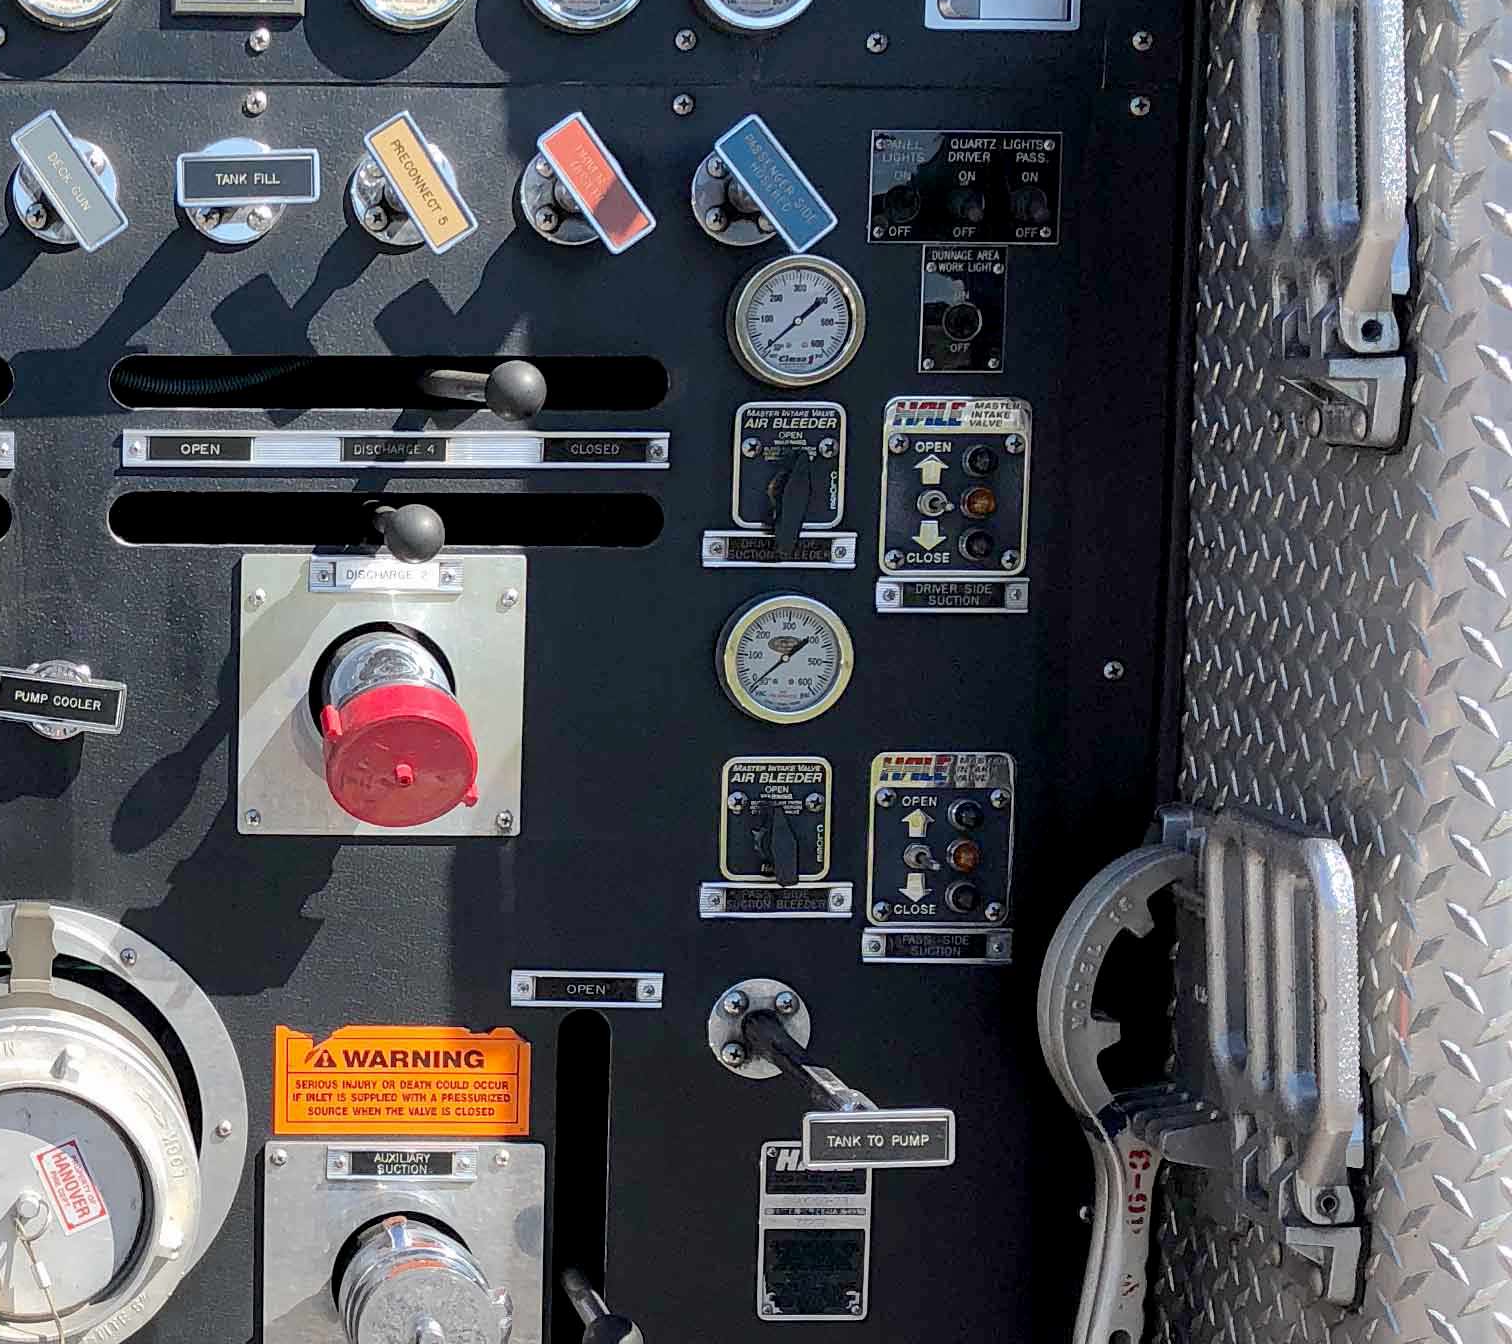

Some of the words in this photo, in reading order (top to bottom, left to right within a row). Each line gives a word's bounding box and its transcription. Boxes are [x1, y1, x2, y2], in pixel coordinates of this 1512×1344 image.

[950, 138, 996, 150] QUARTZ
[1003, 140, 1044, 150] LIGHTS
[882, 151, 925, 162] LIGHTS
[948, 152, 991, 162] DRIVER
[216, 173, 248, 185] TANK
[254, 172, 281, 185] FILL
[390, 139, 442, 215] PRECONNECT
[958, 171, 976, 182] ON
[1022, 172, 1038, 182] ON
[888, 226, 912, 237] OFF
[952, 228, 976, 238] OFF
[1015, 228, 1038, 238] OFF
[932, 251, 972, 260] DUNNAGE
[976, 251, 1000, 260] AREA
[938, 262, 964, 272] WORK
[968, 263, 993, 272] LIGHT
[950, 344, 970, 352] OFF
[744, 418, 772, 429] AIR
[773, 418, 837, 430] BLEEDER
[968, 420, 1002, 428] VALVE
[778, 431, 803, 440] OPEN
[180, 443, 220, 455] OPEN
[353, 444, 422, 456] DISCHARGE
[426, 444, 436, 455] 4
[570, 444, 620, 455] CLOSED
[915, 442, 952, 453] OPEN
[906, 552, 950, 564] CLOSE
[346, 568, 416, 581] DISCHARGE
[915, 584, 958, 594] DRIVER
[965, 584, 992, 594] SIDE
[928, 594, 980, 606] SUCTION
[14, 690, 48, 706] PUMP
[52, 694, 102, 711] COOLER
[731, 772, 756, 783] AIR
[758, 772, 822, 784] BLEEDER
[764, 786, 788, 794] OPEN
[902, 796, 937, 807] OPEN
[894, 904, 936, 916] CLOSE
[911, 946, 961, 957] SUCTION
[566, 984, 607, 996] OPEN
[343, 1049, 485, 1068] WARNING
[295, 1080, 338, 1090] SERIOUS
[342, 1080, 378, 1090] INJURY
[382, 1080, 396, 1089] OR
[399, 1080, 432, 1090] DEATH
[435, 1080, 470, 1090] COULD
[472, 1080, 510, 1090] OCCUR
[292, 1092, 300, 1102] IF
[304, 1093, 334, 1102] INLET
[336, 1093, 348, 1102] IS
[350, 1093, 398, 1102] SUPPLIED
[402, 1093, 427, 1102] WITH
[430, 1094, 438, 1102] A
[441, 1094, 511, 1103] PRESSURIZED
[308, 1107, 349, 1116] SOURCE
[352, 1107, 382, 1116] WHEN
[385, 1107, 404, 1116] THE
[408, 1108, 438, 1117] VALVE
[442, 1108, 452, 1117] IS
[454, 1108, 495, 1117] CLOSED
[827, 1135, 862, 1148] TANK
[868, 1134, 884, 1146] TO
[891, 1133, 930, 1147] PUMP
[374, 1152, 431, 1164] AUXILIARY
[377, 1164, 428, 1176] SUCTION
[52, 1152, 90, 1220] HANOVER
